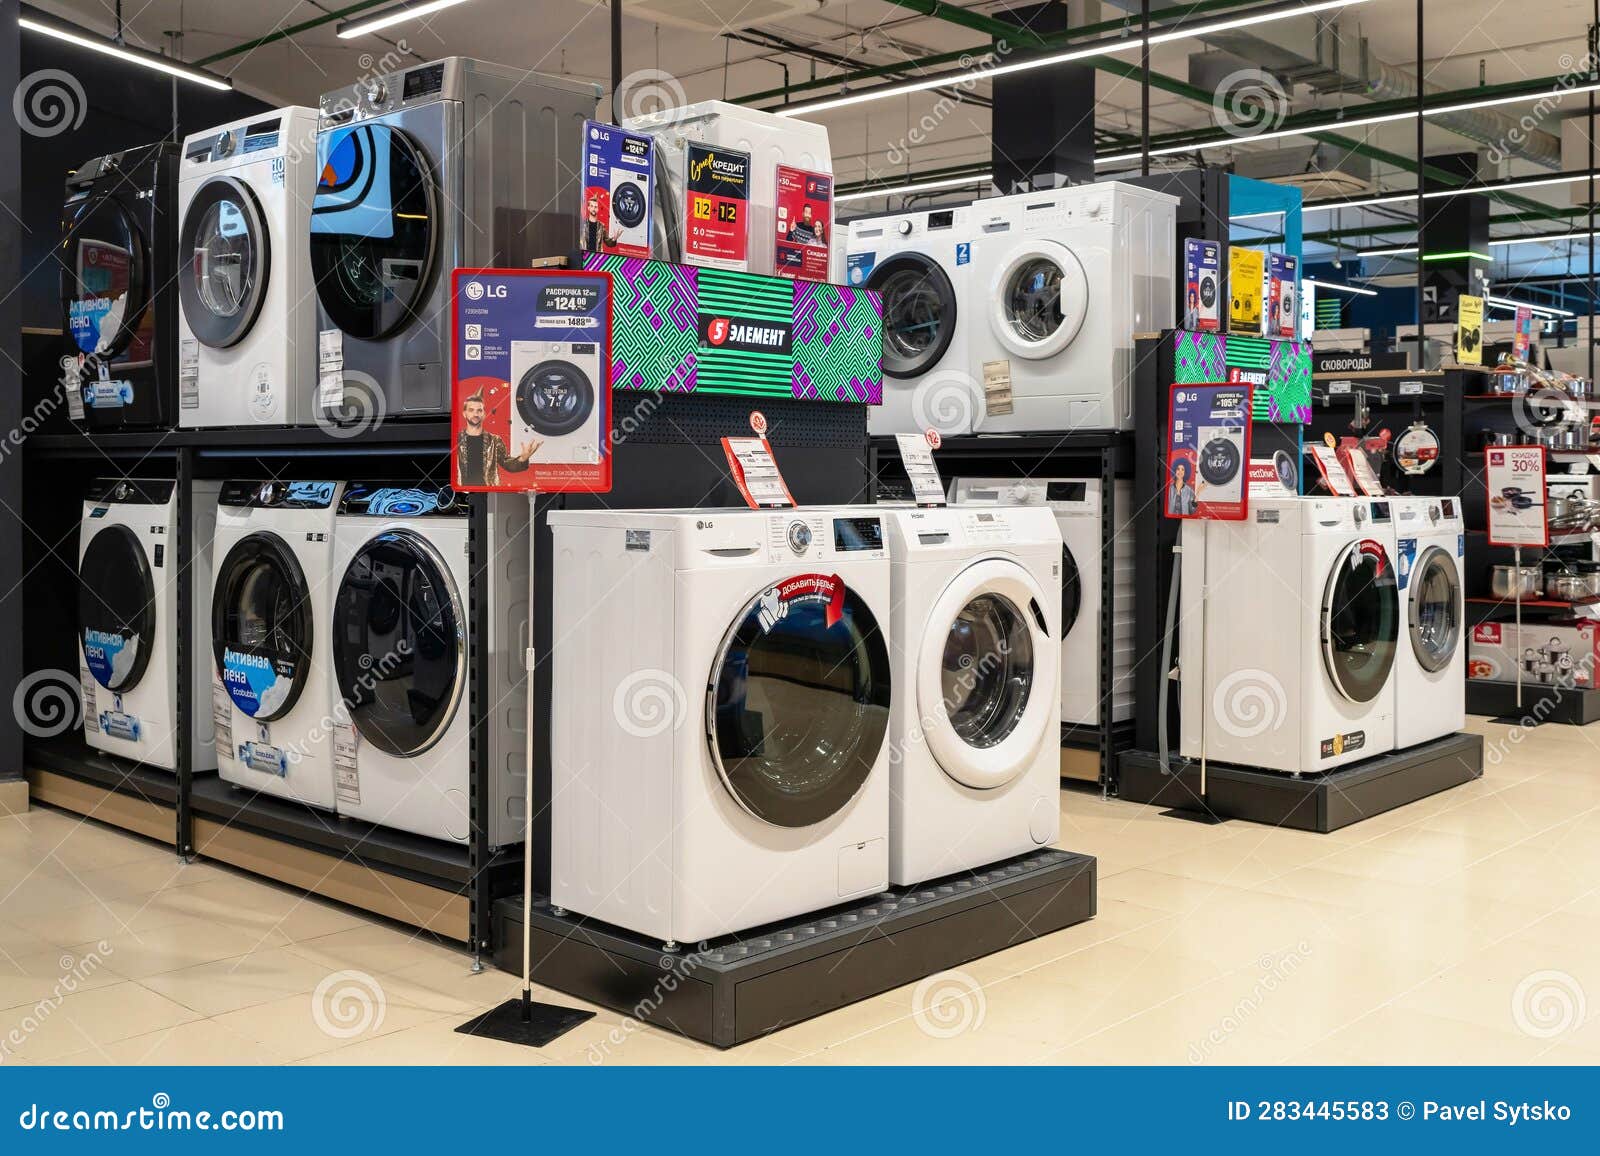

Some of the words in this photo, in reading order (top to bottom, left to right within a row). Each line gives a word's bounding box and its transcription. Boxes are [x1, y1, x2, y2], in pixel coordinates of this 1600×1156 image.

[599, 131, 610, 141] LG
[712, 160, 745, 173] КРЕДИТ
[695, 201, 711, 216] 12
[719, 205, 736, 220] 12
[487, 285, 508, 298] LG
[728, 324, 786, 347] ЭЛЕМЕНТ
[1320, 358, 1372, 371] СКОВОРОДЫ
[1186, 393, 1198, 401] LG
[1511, 460, 1540, 472] 30%
[782, 578, 816, 597] ДОБАВИТЬ
[224, 646, 269, 670] Активная
[223, 668, 247, 684] пена
